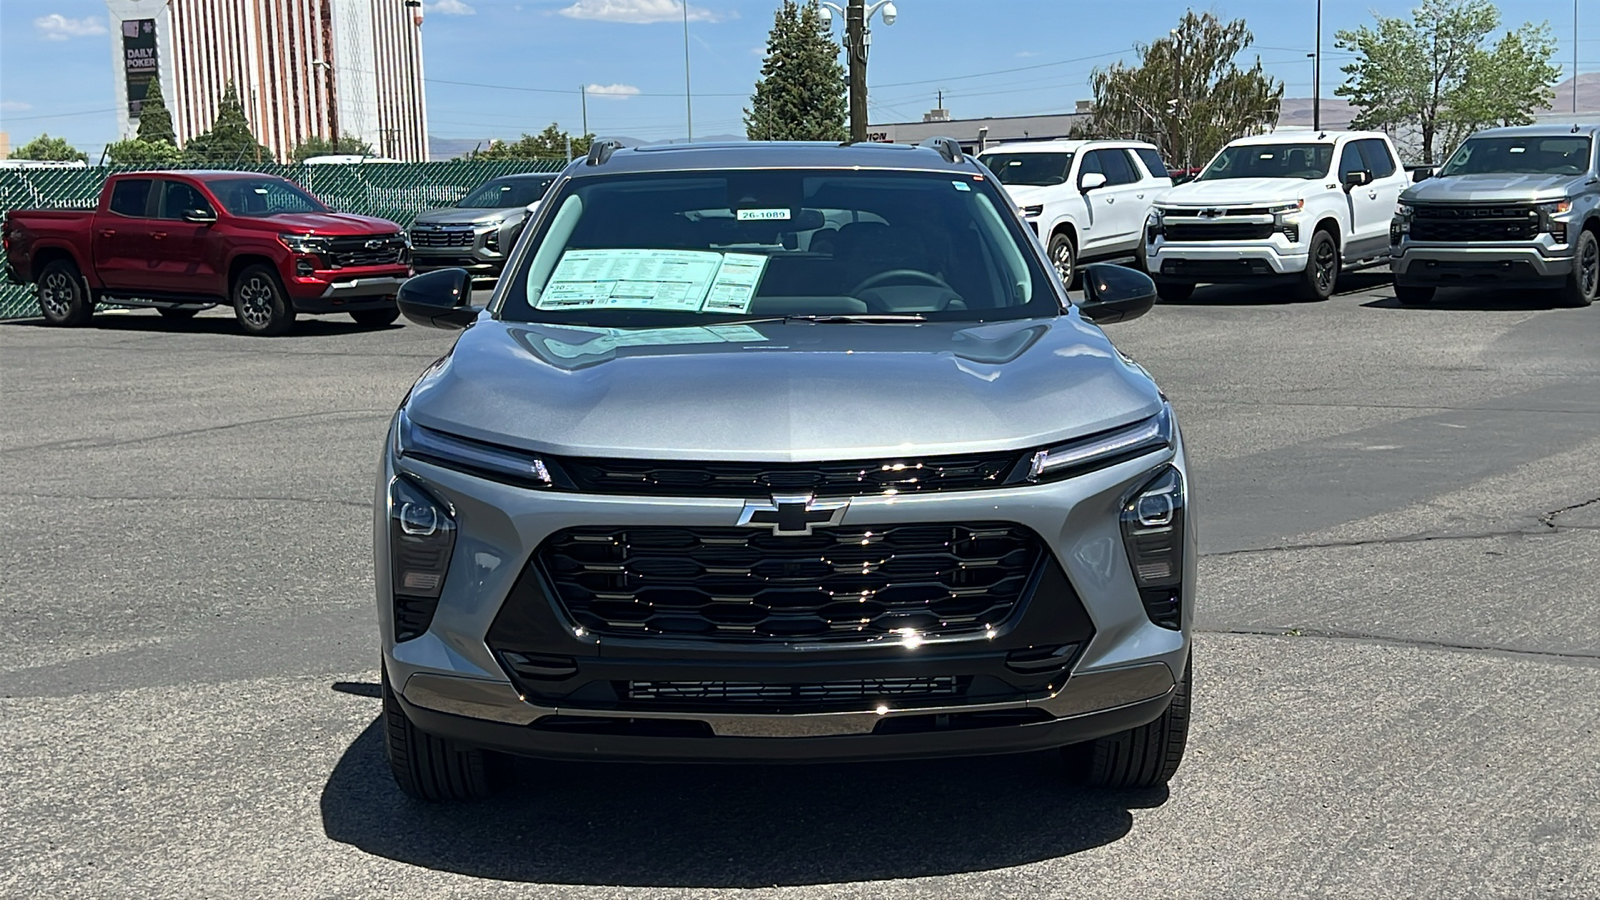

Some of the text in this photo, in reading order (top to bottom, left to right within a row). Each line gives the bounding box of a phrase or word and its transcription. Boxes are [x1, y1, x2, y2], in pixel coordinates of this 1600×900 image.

[127, 48, 153, 58] DAILY
[126, 57, 156, 68] POKER
[742, 211, 785, 219] 26-1089
